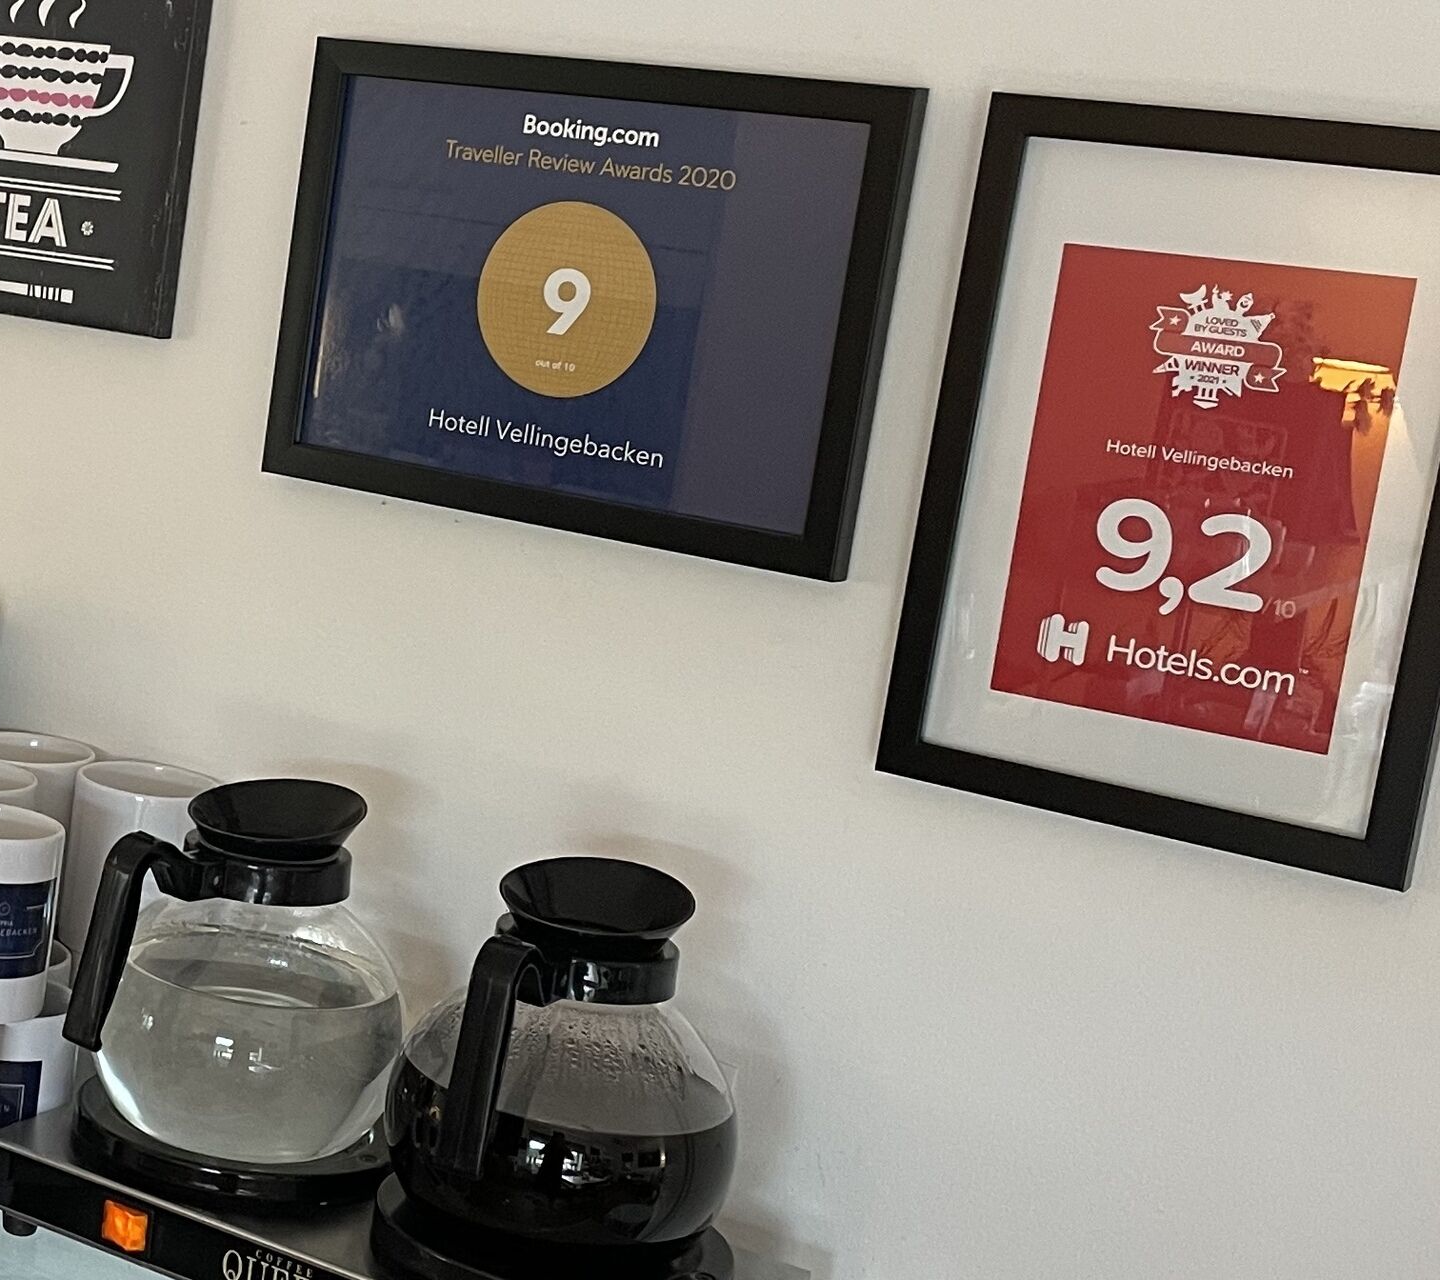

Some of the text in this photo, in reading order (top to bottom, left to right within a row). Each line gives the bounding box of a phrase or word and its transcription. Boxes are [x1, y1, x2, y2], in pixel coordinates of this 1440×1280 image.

[522, 114, 660, 148] Booking.com
[446, 139, 736, 191] Traveller Review Awards 2020
[543, 268, 591, 335] 9
[1194, 323, 1247, 338] BY GUESTS
[1205, 316, 1239, 327] LOVED
[535, 358, 576, 372] out of 10
[1190, 341, 1245, 357] AWARD
[1184, 358, 1240, 376] WINNER
[1197, 373, 1220, 385] 2021
[428, 407, 664, 468] Hotell Vellingebacken
[1106, 439, 1294, 479] Hotell Vellingebacken
[1095, 498, 1272, 615] 9,2
[1107, 634, 1296, 696] Hotels.com
[255, 1248, 313, 1279] COFFEE
